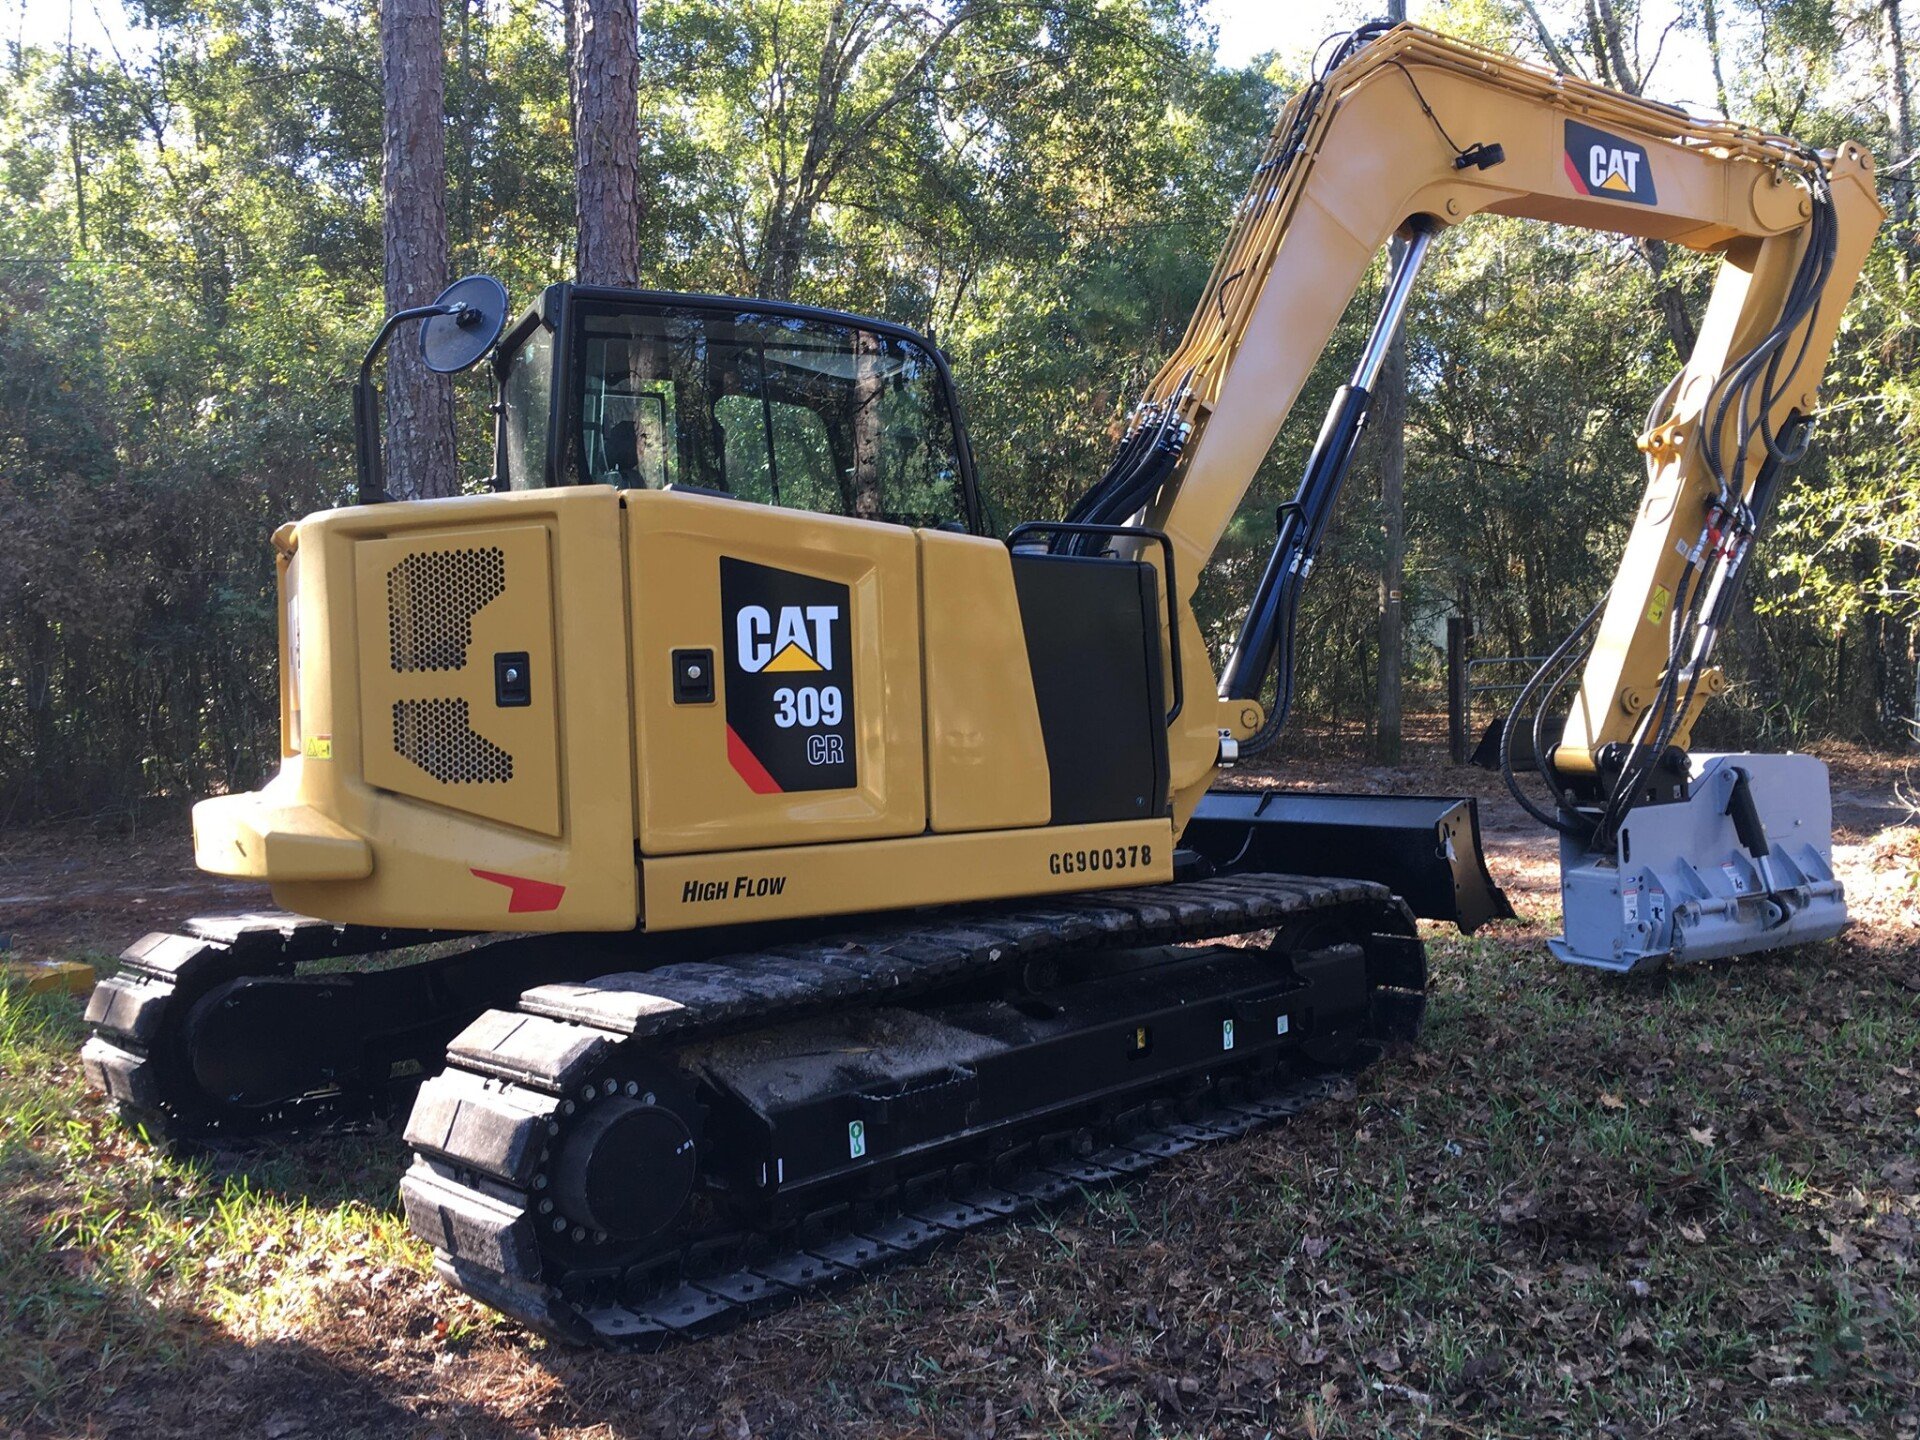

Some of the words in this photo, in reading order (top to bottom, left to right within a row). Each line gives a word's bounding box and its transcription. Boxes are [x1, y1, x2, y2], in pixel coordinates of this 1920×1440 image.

[1589, 144, 1641, 194] CAT
[736, 604, 839, 673] CAT
[773, 685, 843, 729] 309
[807, 734, 845, 766] CR
[1049, 844, 1152, 875] GG900378
[681, 880, 730, 903] HIGH
[733, 876, 787, 899] FLOW
